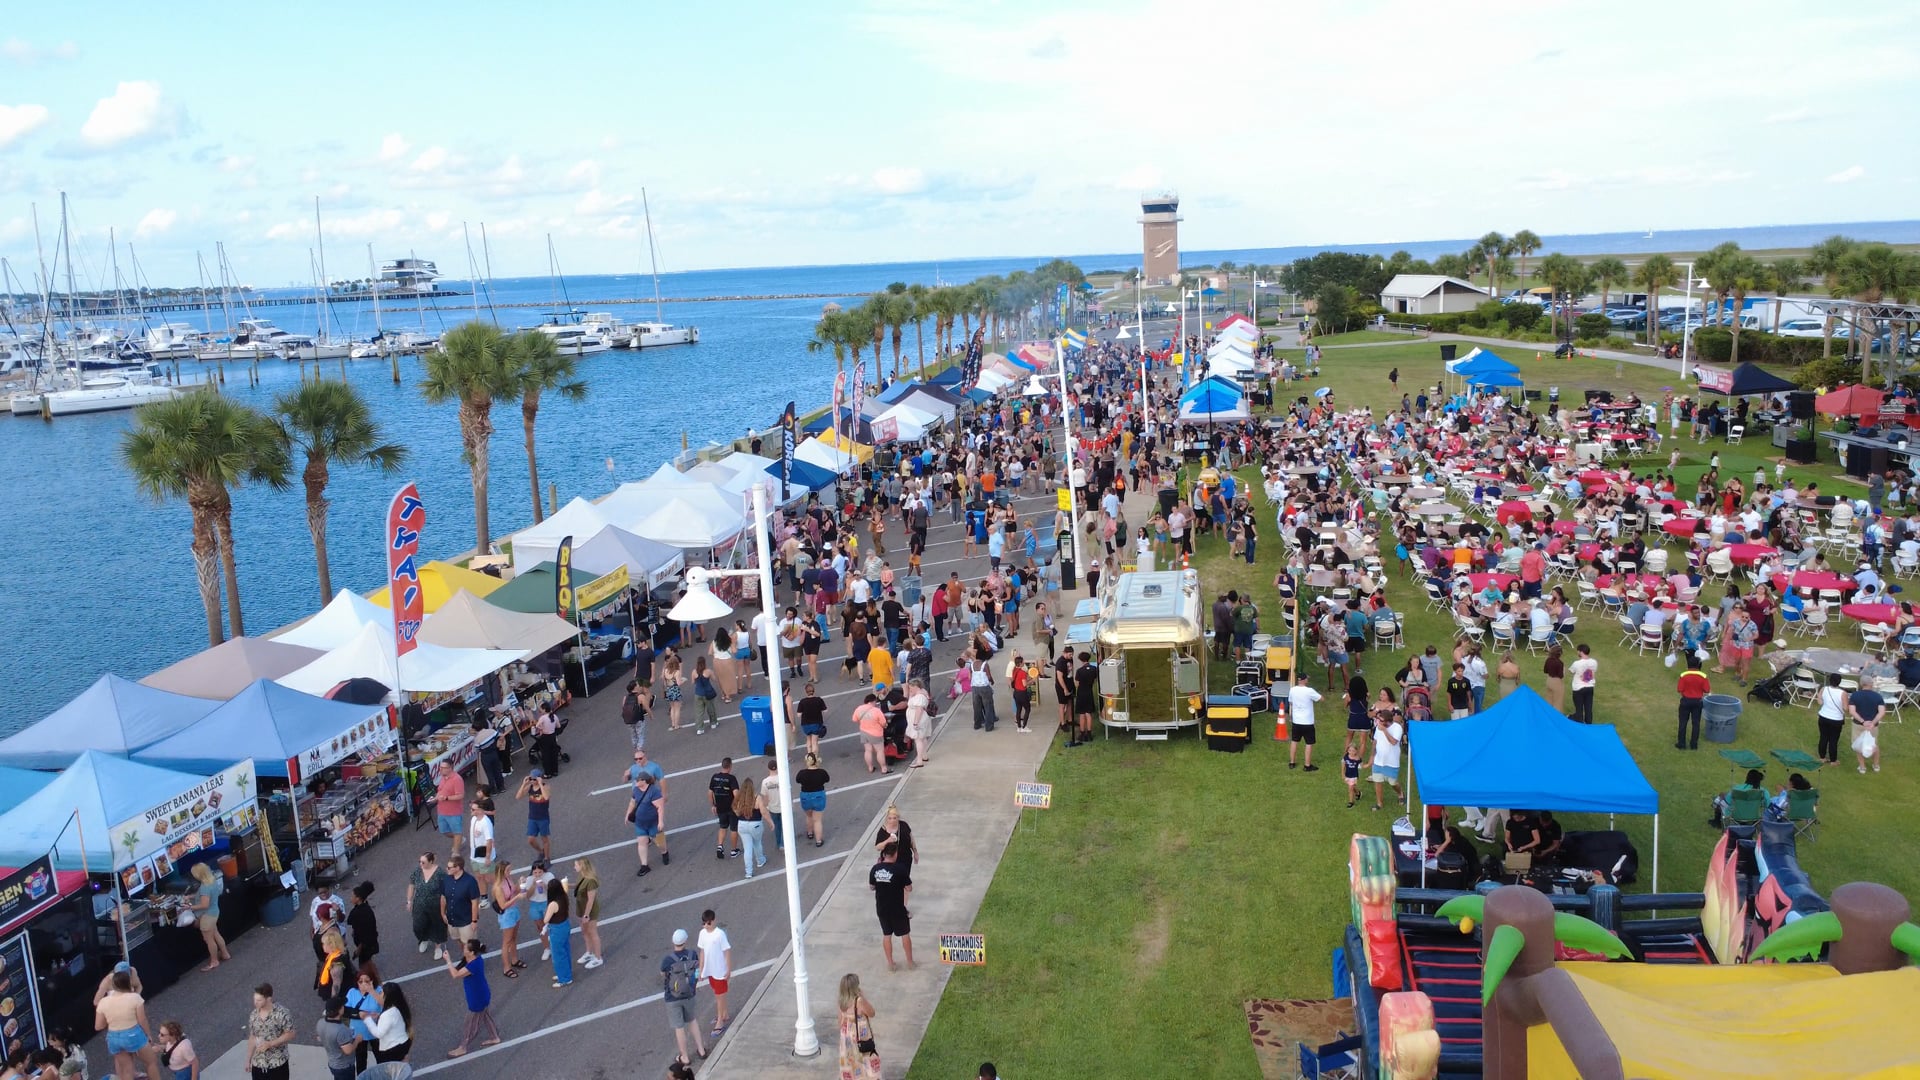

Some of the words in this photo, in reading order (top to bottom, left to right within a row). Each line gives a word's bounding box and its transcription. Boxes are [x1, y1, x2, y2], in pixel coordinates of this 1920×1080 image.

[784, 429, 794, 490] KOREAN
[393, 496, 424, 610] THAI
[559, 546, 572, 609] BBQ
[307, 760, 324, 775] GRILL
[145, 800, 172, 823] SWEET
[173, 785, 206, 809] BANANA
[206, 774, 224, 792] LEAF
[1016, 782, 1050, 795] MERCHANDISE
[1021, 794, 1043, 806] VENDORS
[161, 834, 173, 844] LAO
[205, 809, 221, 821] MORE
[940, 935, 983, 949] MERCHANDISE
[949, 949, 977, 962] VENDORS
